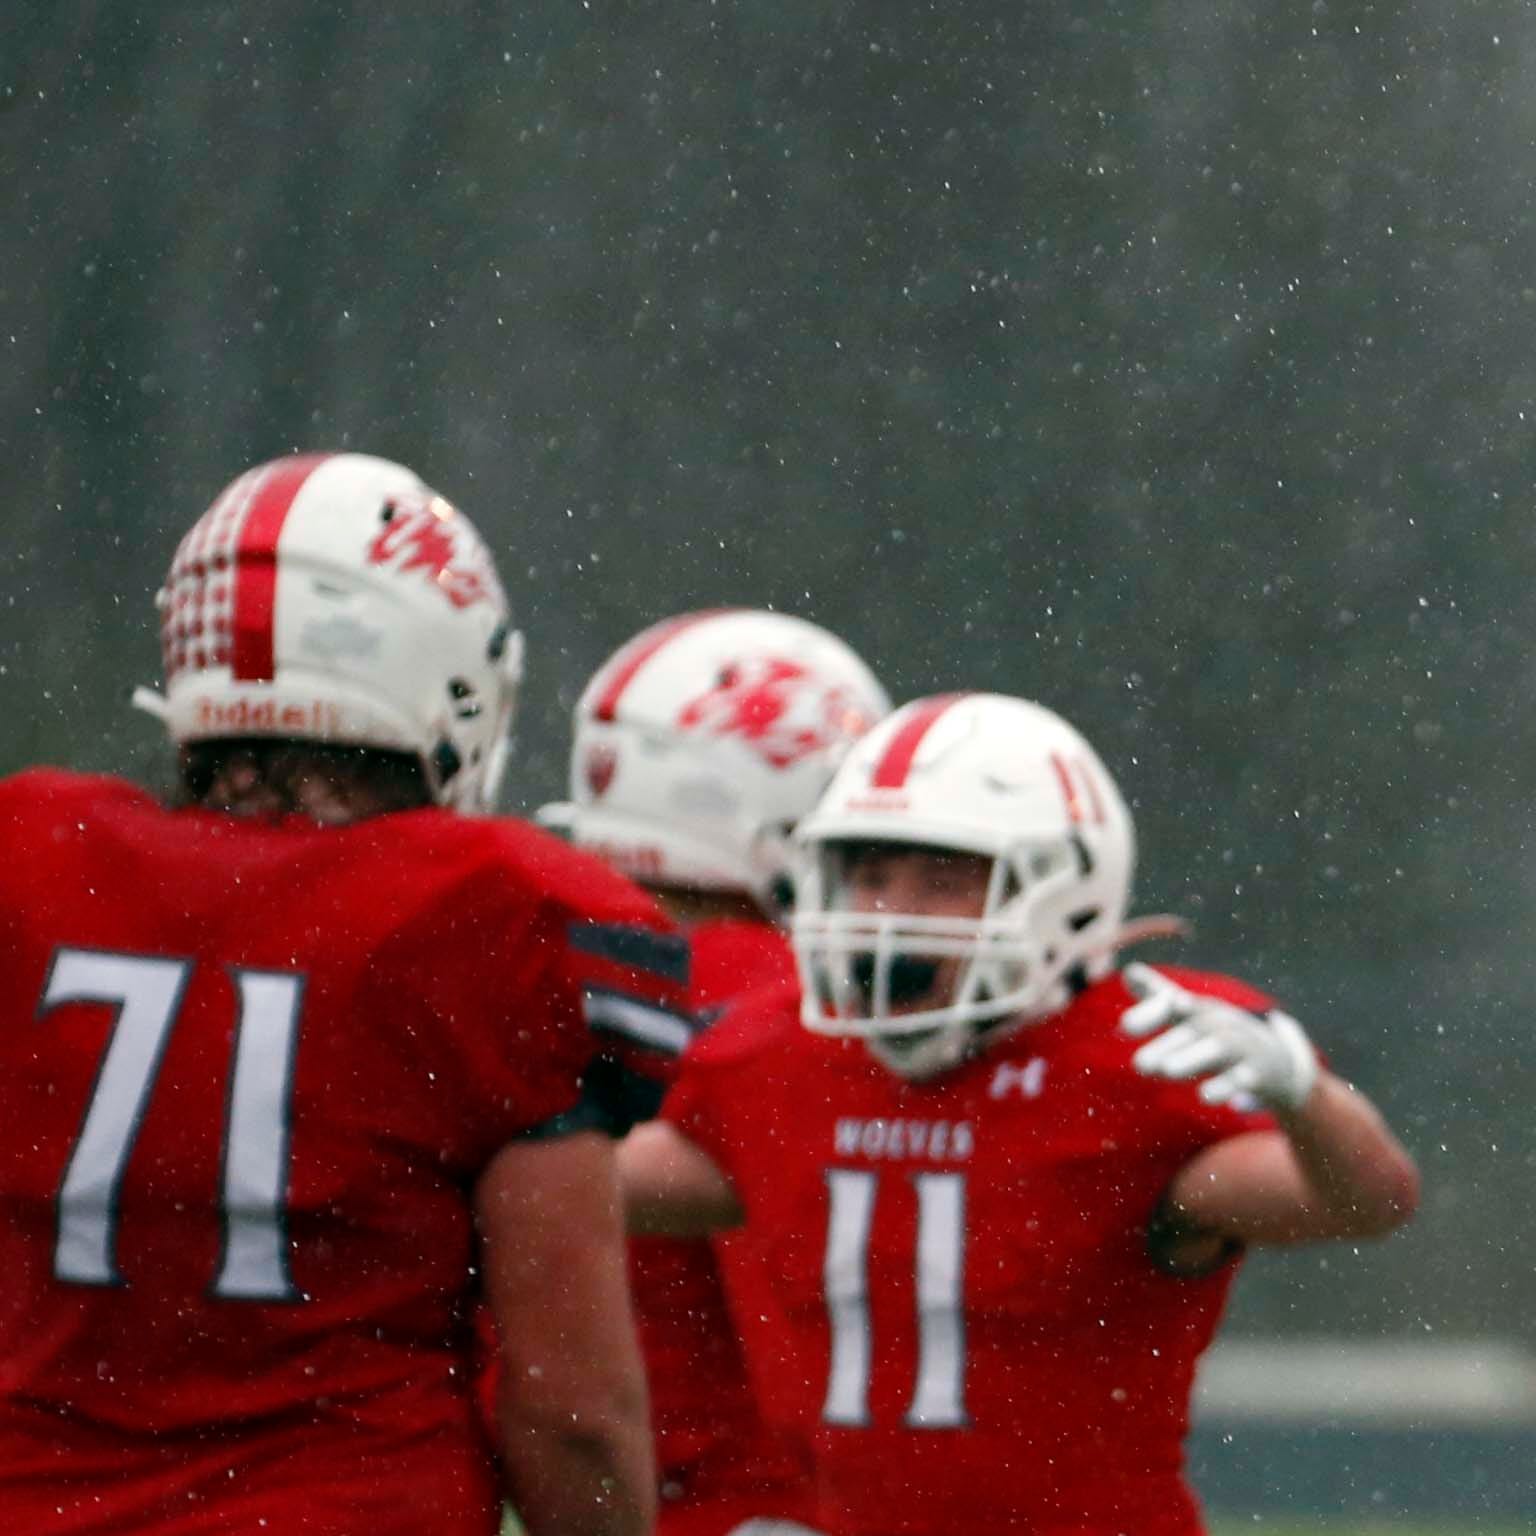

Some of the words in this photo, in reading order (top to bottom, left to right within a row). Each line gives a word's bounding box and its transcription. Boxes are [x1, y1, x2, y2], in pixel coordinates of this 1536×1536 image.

[36, 947, 308, 1300] 71
[834, 1117, 974, 1160] WOLVES
[820, 1168, 970, 1430] 11
